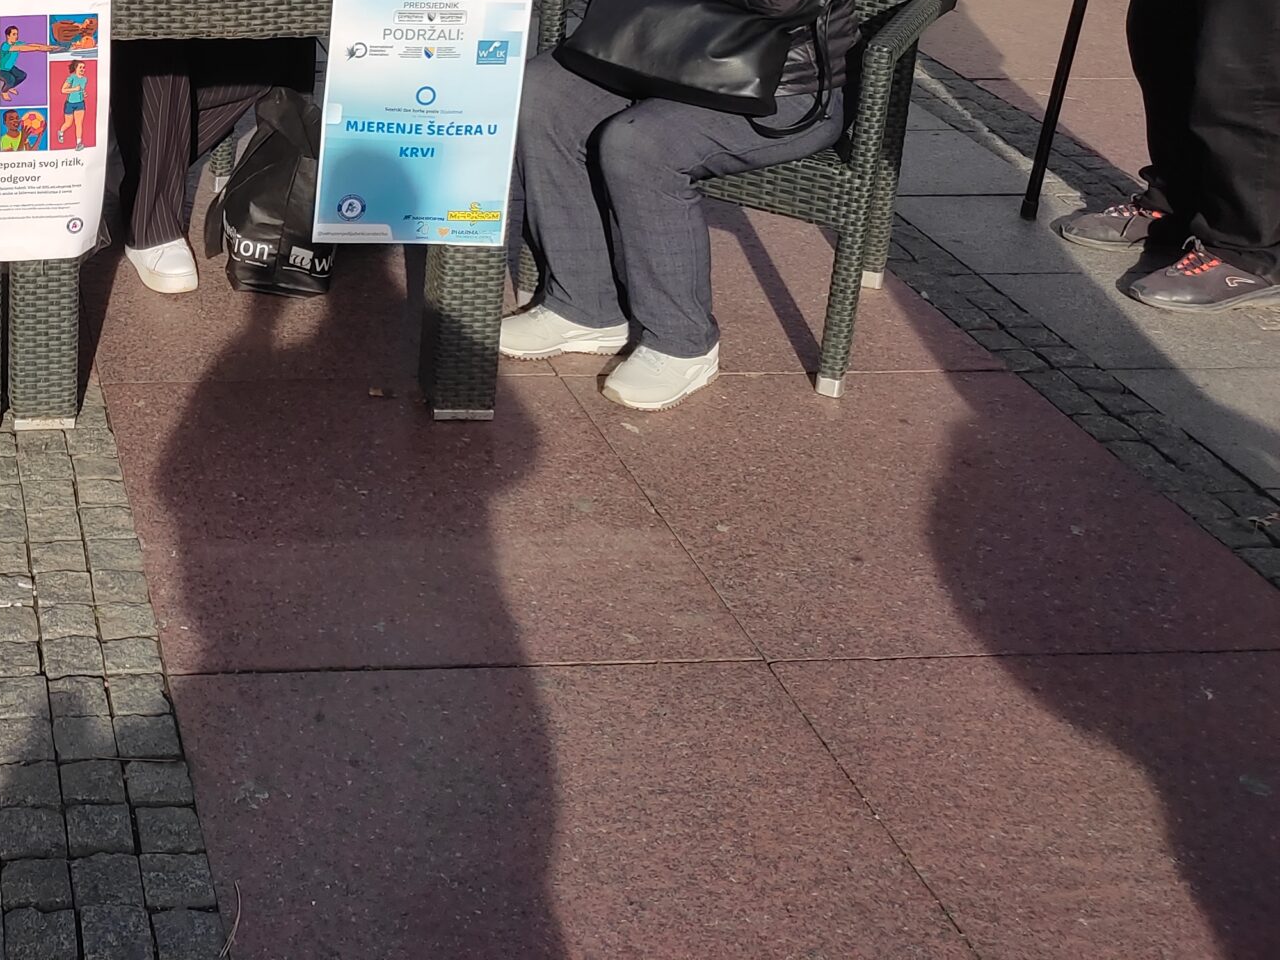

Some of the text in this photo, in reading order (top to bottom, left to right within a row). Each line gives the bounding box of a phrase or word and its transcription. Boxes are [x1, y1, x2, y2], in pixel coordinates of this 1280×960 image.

[403, 1, 460, 9] PREDSJEDNIK
[382, 26, 464, 41] PODRŽALI:
[345, 120, 497, 136] MJERENJE ŠEĆERA U
[399, 146, 435, 158] KRVI
[39, 159, 58, 170] svoj
[61, 157, 84, 167] rizik,
[0, 173, 41, 184] odgovor
